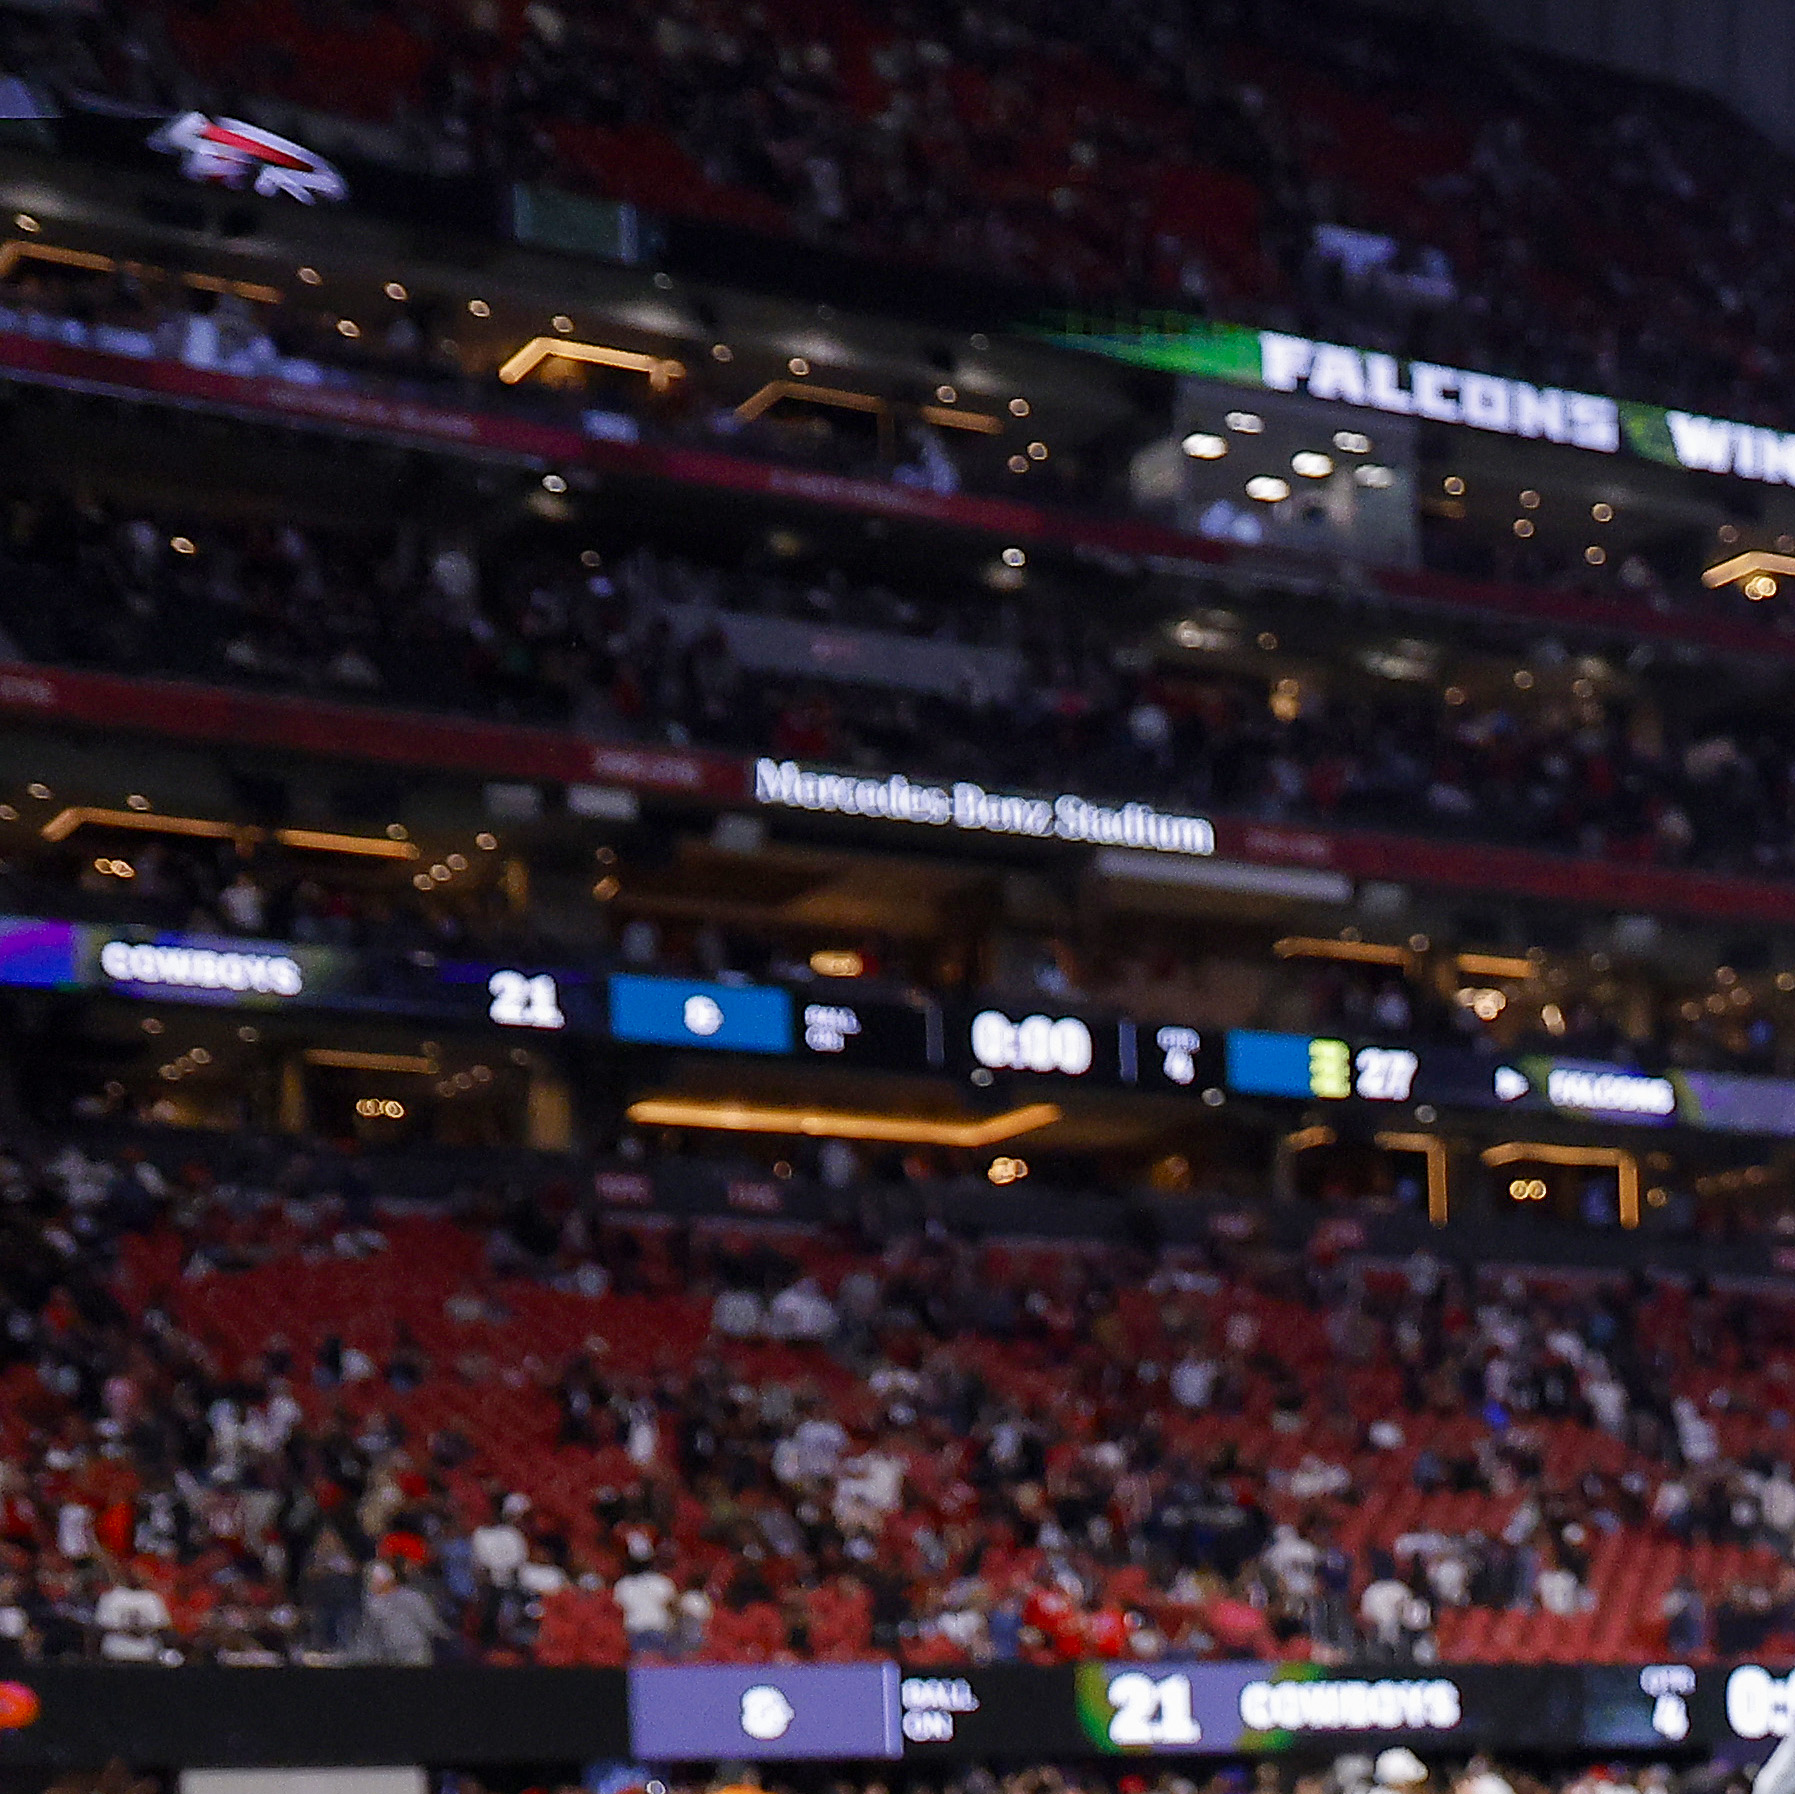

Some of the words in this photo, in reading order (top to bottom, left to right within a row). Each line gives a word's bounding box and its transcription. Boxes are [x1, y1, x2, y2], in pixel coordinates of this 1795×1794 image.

[1258, 330, 1621, 453] FALCONS
[1054, 794, 1215, 856] Stadium
[101, 941, 302, 997] COWBOYS
[488, 970, 566, 1030] 21
[1108, 1671, 1202, 1747] 21
[1238, 1680, 1462, 1731] COWBOYS
